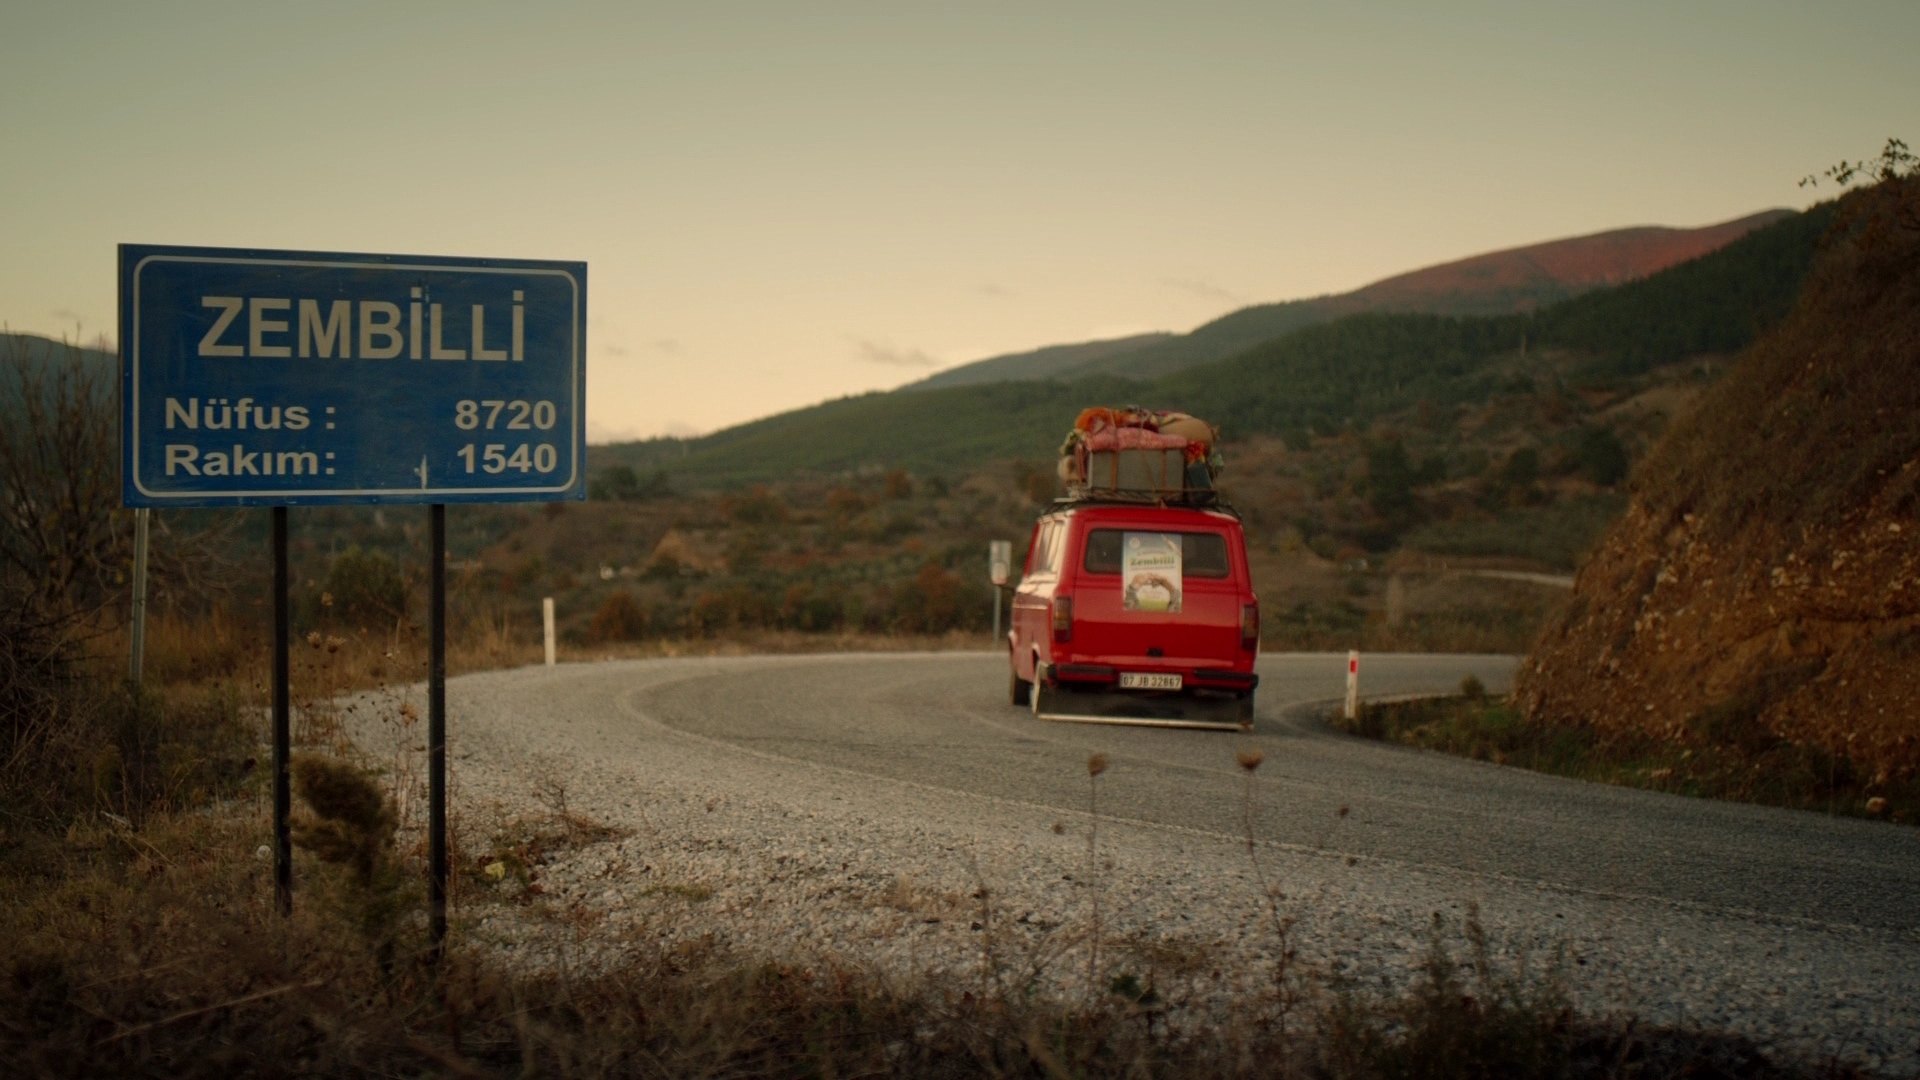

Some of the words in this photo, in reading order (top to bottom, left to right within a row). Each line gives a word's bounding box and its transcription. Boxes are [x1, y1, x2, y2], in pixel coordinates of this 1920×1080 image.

[198, 286, 525, 361] ZEMBİLLİ
[165, 397, 311, 430] Nüfus
[455, 400, 557, 430] 8720
[165, 444, 336, 476] Rakım:
[457, 444, 558, 474] 1540
[1123, 676, 1135, 686] 07
